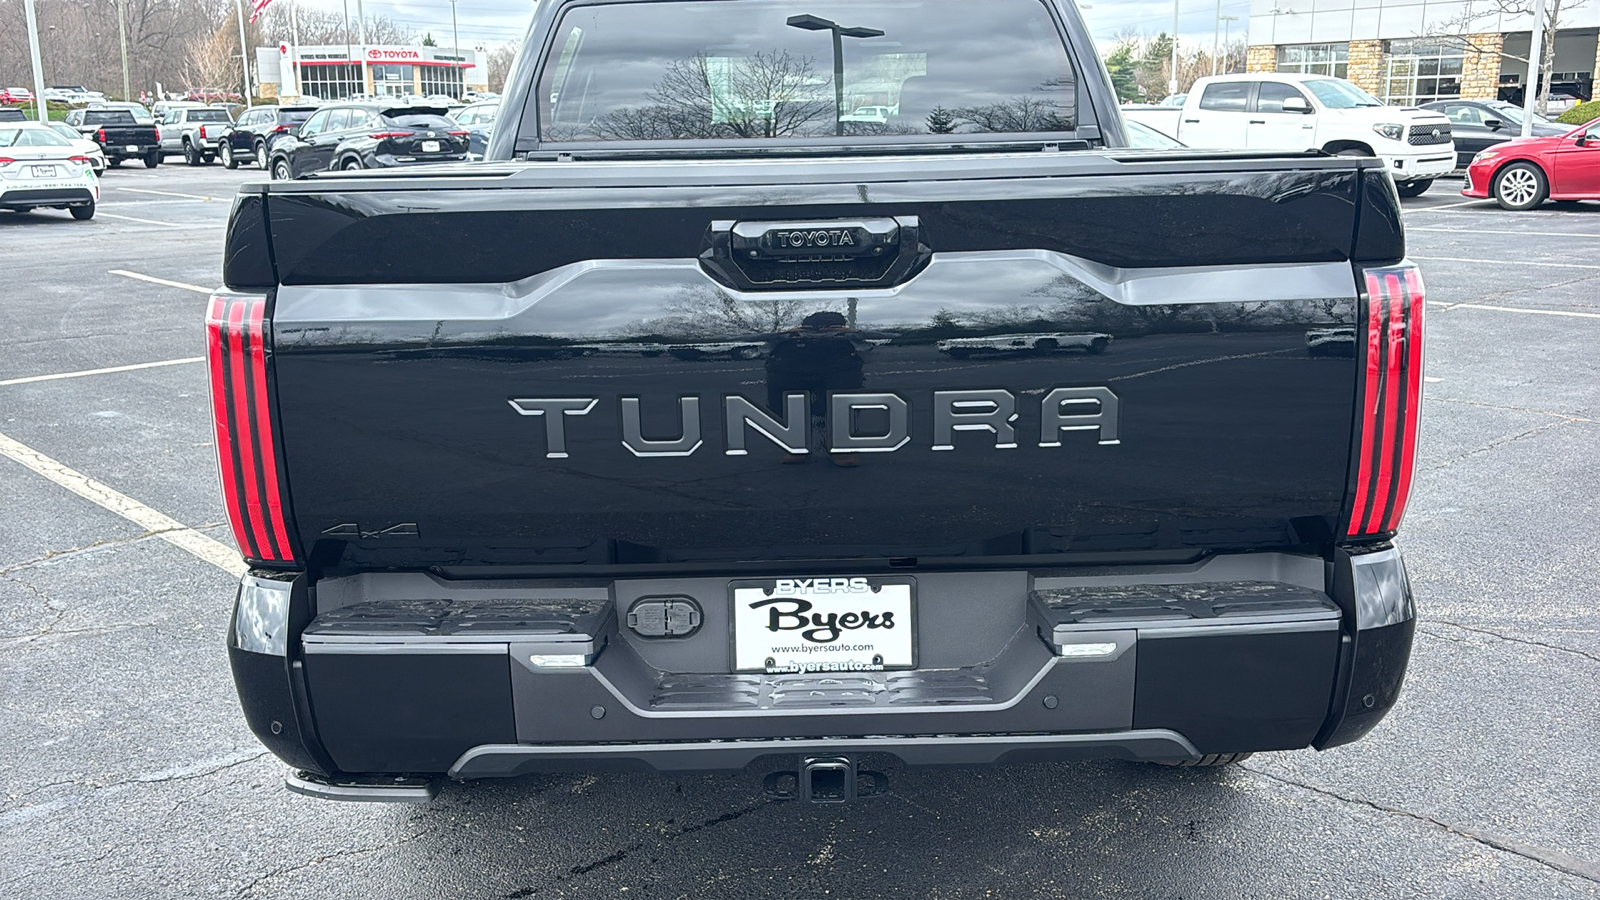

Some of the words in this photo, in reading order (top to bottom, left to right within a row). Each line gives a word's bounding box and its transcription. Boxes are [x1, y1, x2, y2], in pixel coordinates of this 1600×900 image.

[383, 50, 419, 59] TOYOTA
[777, 230, 854, 247] TOYOTA
[508, 386, 1122, 459] TUNDRA
[775, 577, 869, 596] BYERS
[748, 597, 895, 643] Byers
[771, 643, 874, 655] www.byersauto.com
[766, 659, 884, 674] www.byersauto.com
